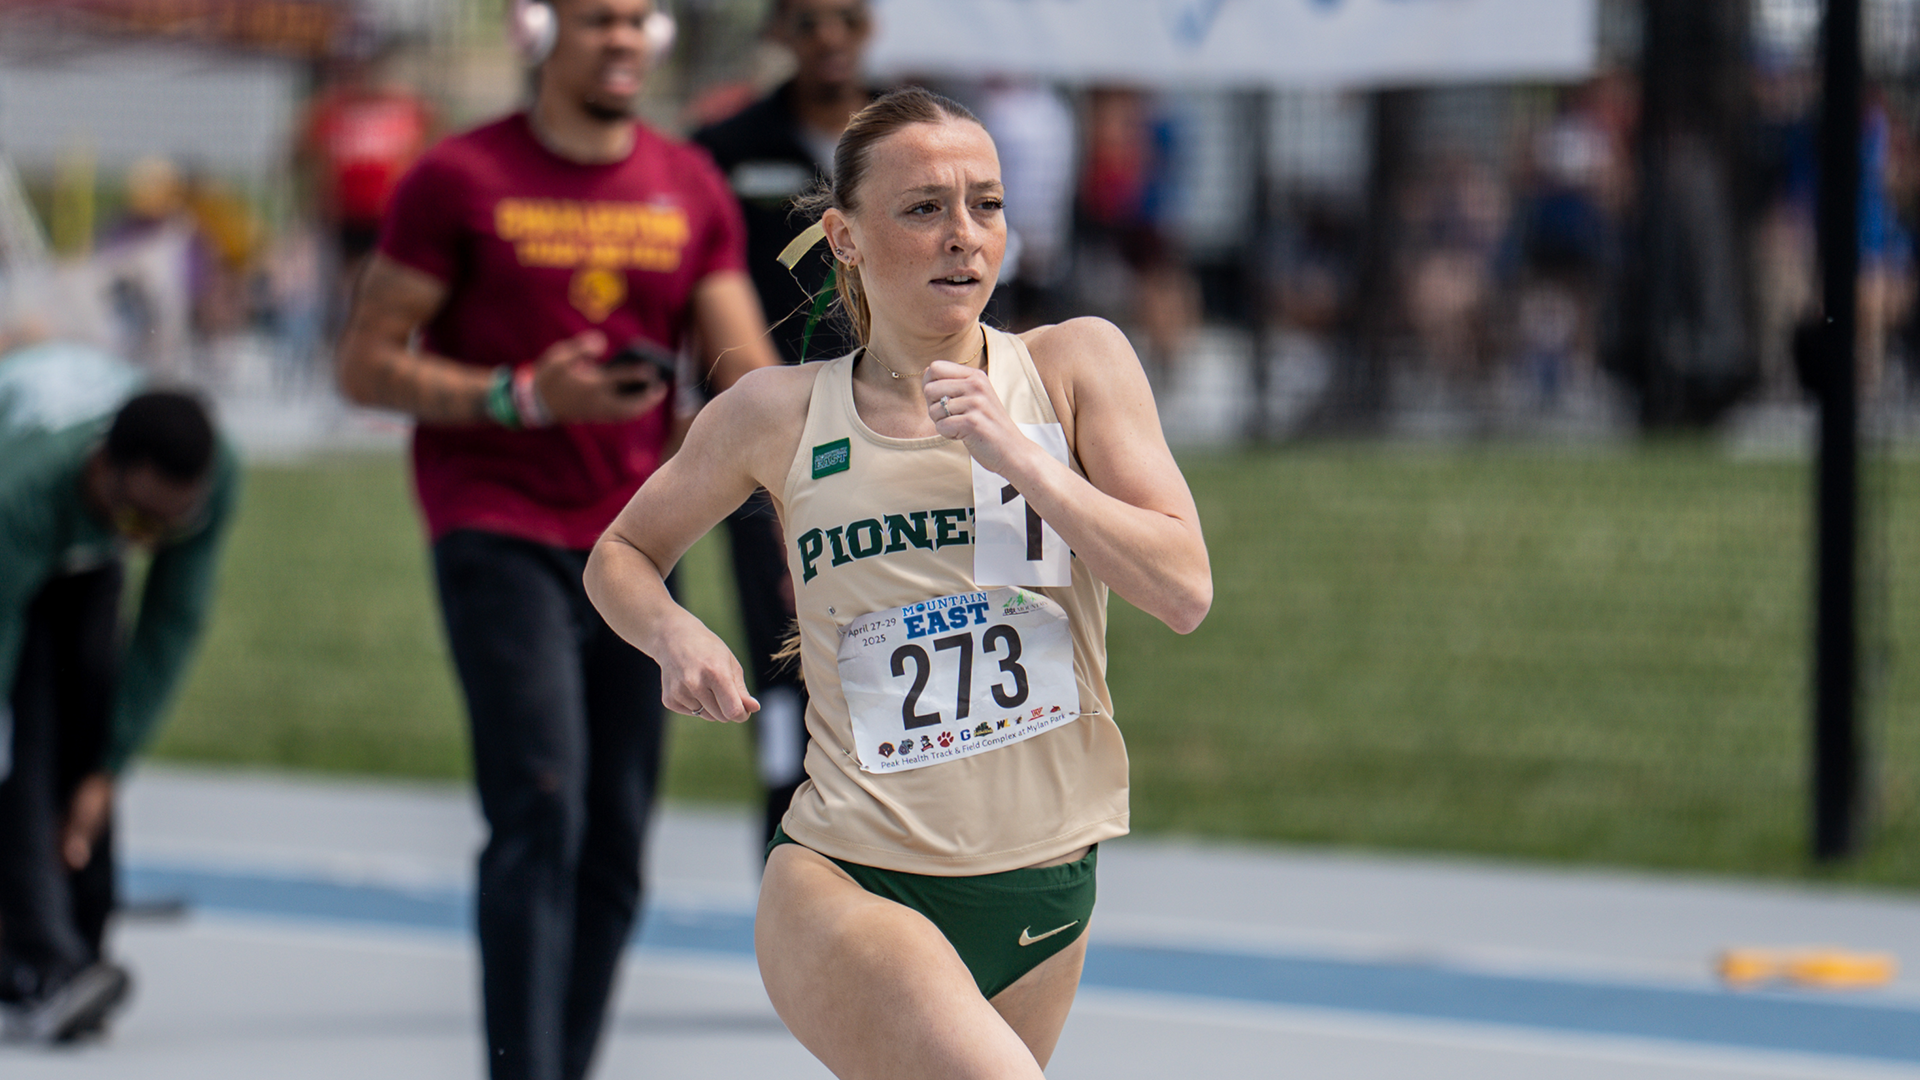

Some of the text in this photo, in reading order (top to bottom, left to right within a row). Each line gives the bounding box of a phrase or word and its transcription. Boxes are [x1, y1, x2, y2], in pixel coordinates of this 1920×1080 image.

[815, 452, 847, 471] EAST
[797, 507, 976, 585] PIONE
[902, 592, 988, 617] MOUNTAIN
[847, 618, 897, 638] April 27-29
[903, 602, 990, 640] EAST
[862, 634, 887, 647] 2025
[890, 624, 1029, 731] 273
[881, 760, 900, 769] Peak
[902, 755, 929, 766] Health
[931, 749, 953, 760] Track
[954, 747, 961, 755] &
[962, 741, 980, 752] Field
[982, 732, 1017, 747] Complex
[1018, 729, 1026, 737] at
[1027, 720, 1049, 733] Mylan
[1050, 713, 1065, 724] Park
